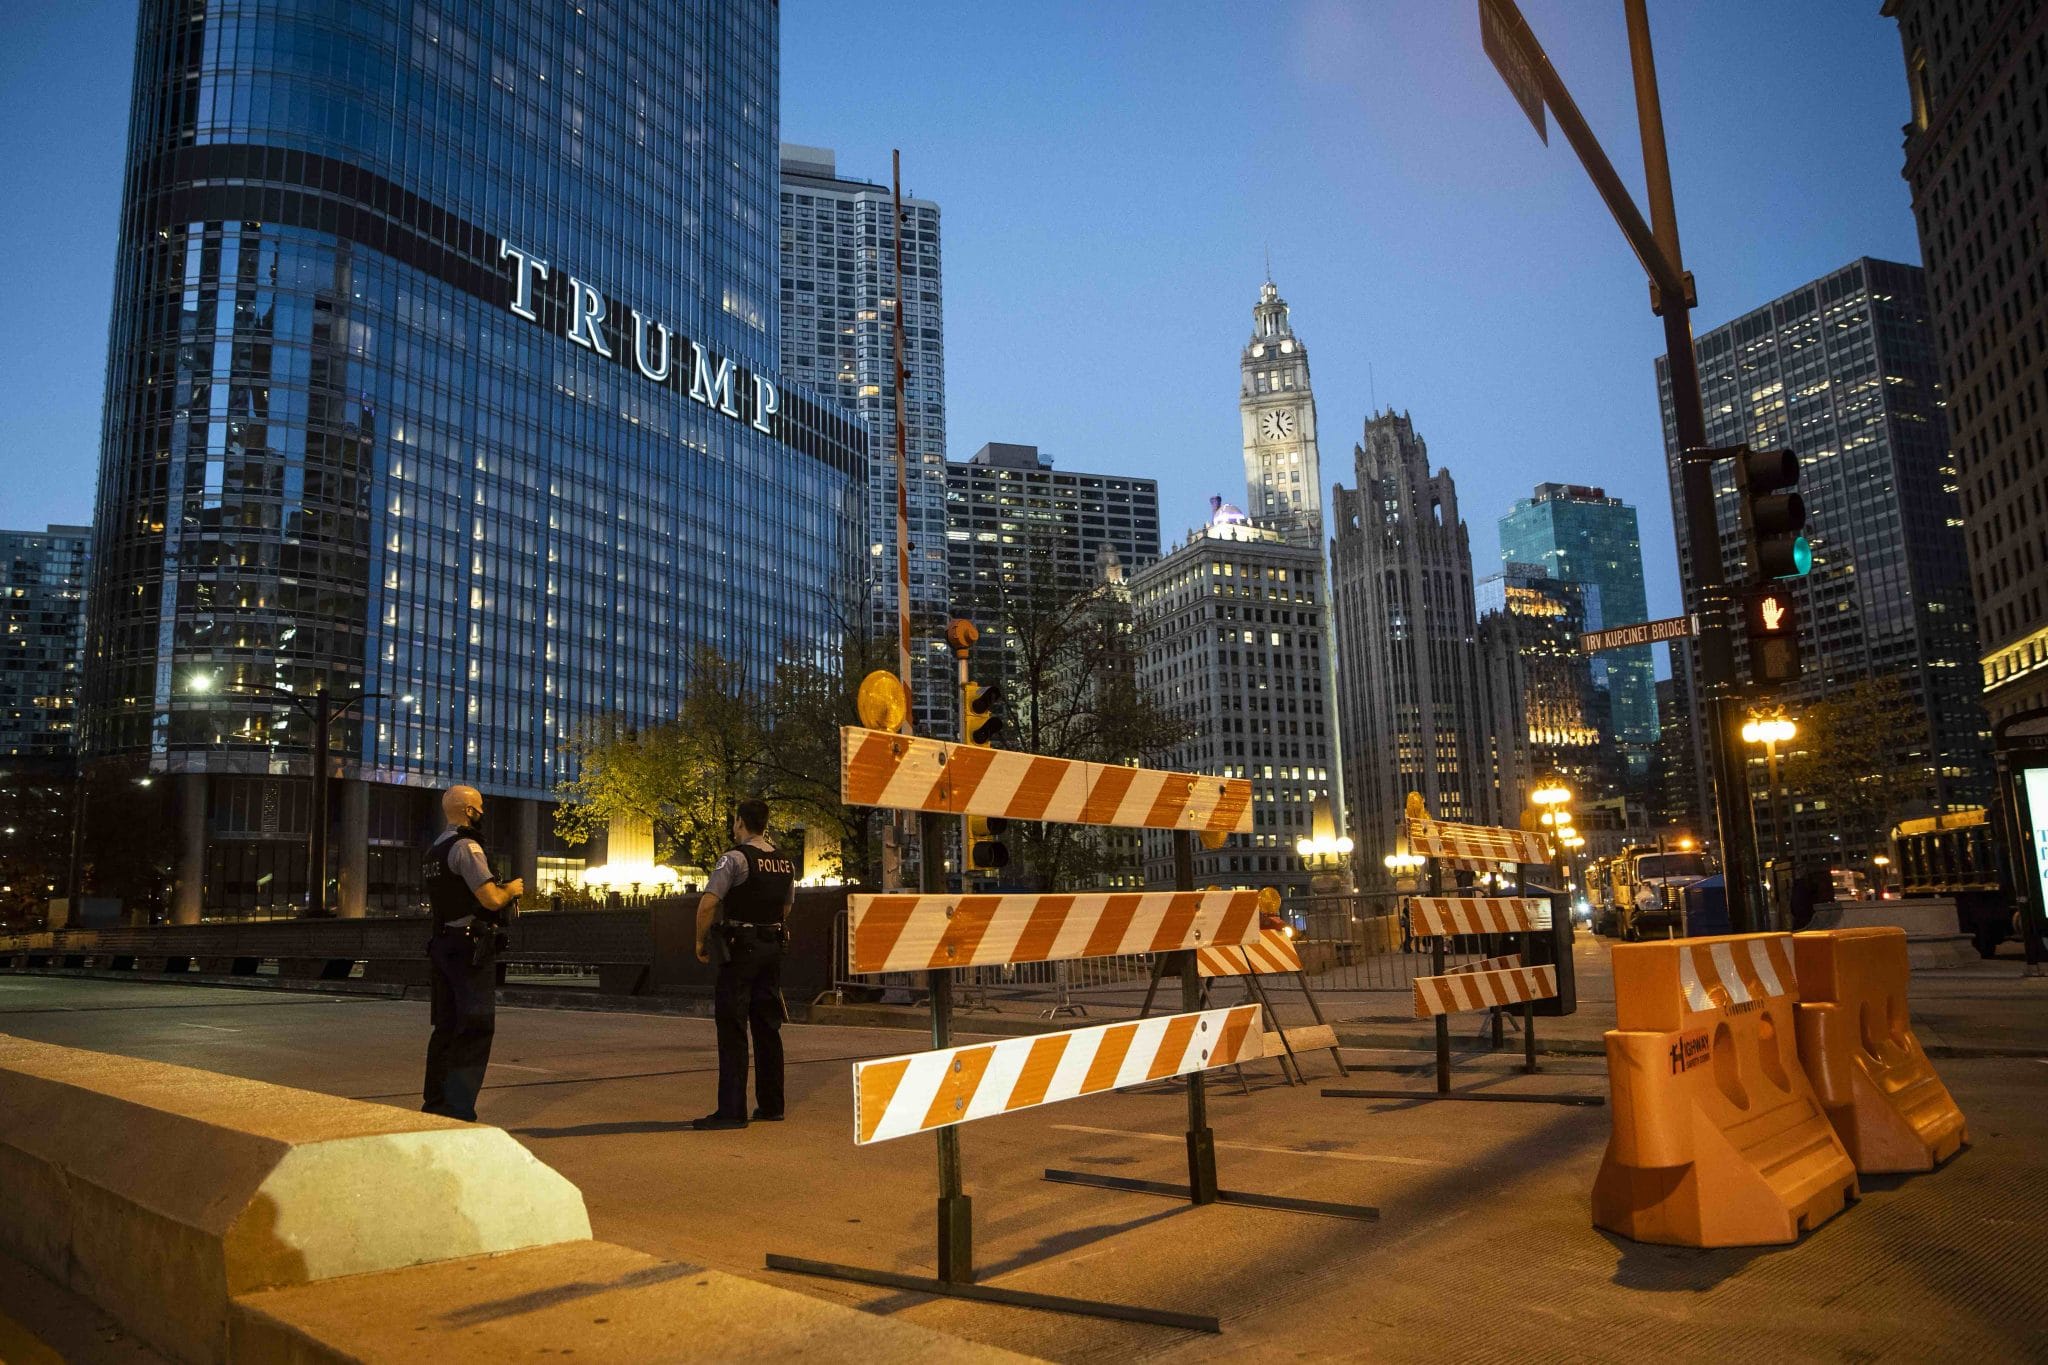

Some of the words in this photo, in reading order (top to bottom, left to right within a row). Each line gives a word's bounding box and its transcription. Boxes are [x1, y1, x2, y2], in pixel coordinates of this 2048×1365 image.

[501, 239, 780, 434] TRUMP
[1586, 634, 1602, 651] IRV
[1605, 626, 1649, 647] KUPCINET
[1652, 619, 1688, 640] BRIDGE
[757, 859, 791, 873] POLICE
